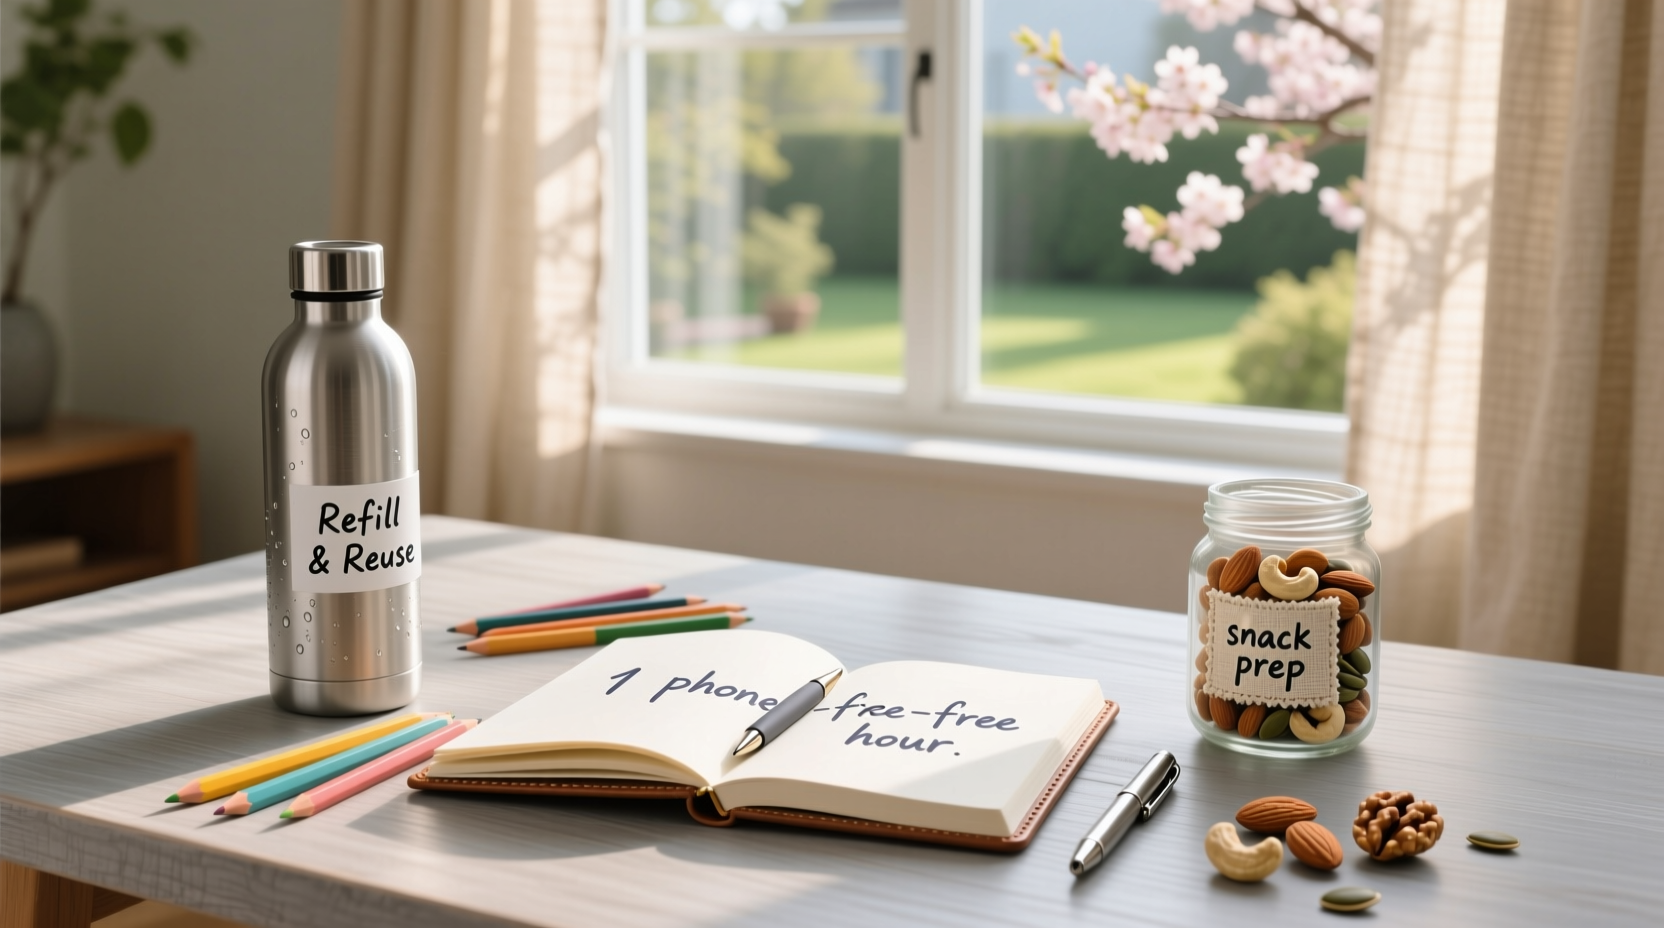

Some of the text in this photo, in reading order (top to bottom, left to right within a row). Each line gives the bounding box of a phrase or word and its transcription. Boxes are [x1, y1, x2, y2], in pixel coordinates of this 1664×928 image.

[319, 495, 400, 536] Refill
[308, 543, 415, 575] & Reuse
[1227, 622, 1312, 650] snack
[605, 667, 641, 695] 1
[1235, 656, 1305, 692] prep
[844, 723, 961, 757] hour.
